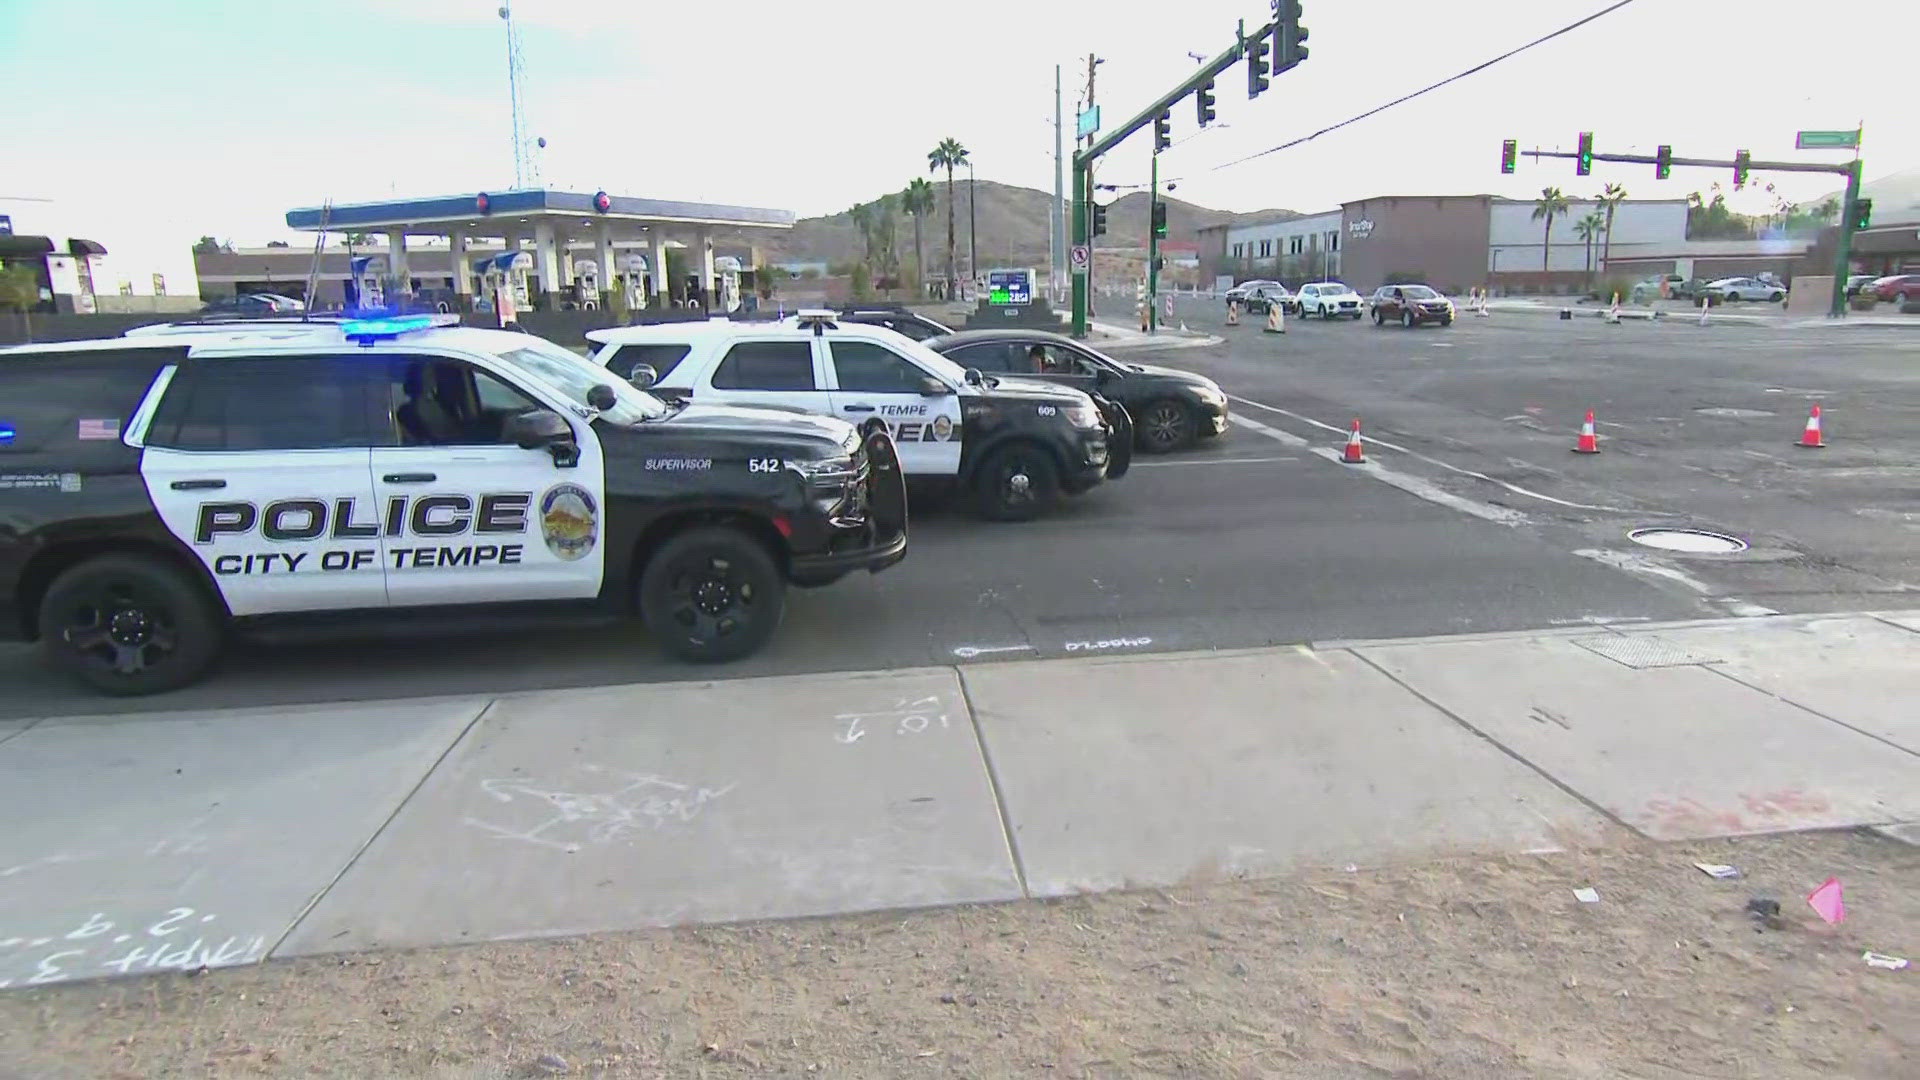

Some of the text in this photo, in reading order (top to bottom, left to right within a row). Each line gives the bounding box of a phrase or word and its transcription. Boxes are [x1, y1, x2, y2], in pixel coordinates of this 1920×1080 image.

[879, 404, 928, 416] TEMPE
[1037, 405, 1056, 417] 609
[644, 458, 712, 471] SUPERVISOR
[748, 457, 780, 473] 542
[194, 491, 534, 545] POLICE
[215, 552, 309, 575] CITY
[321, 549, 376, 571] OF
[390, 544, 524, 568] TEMPE
